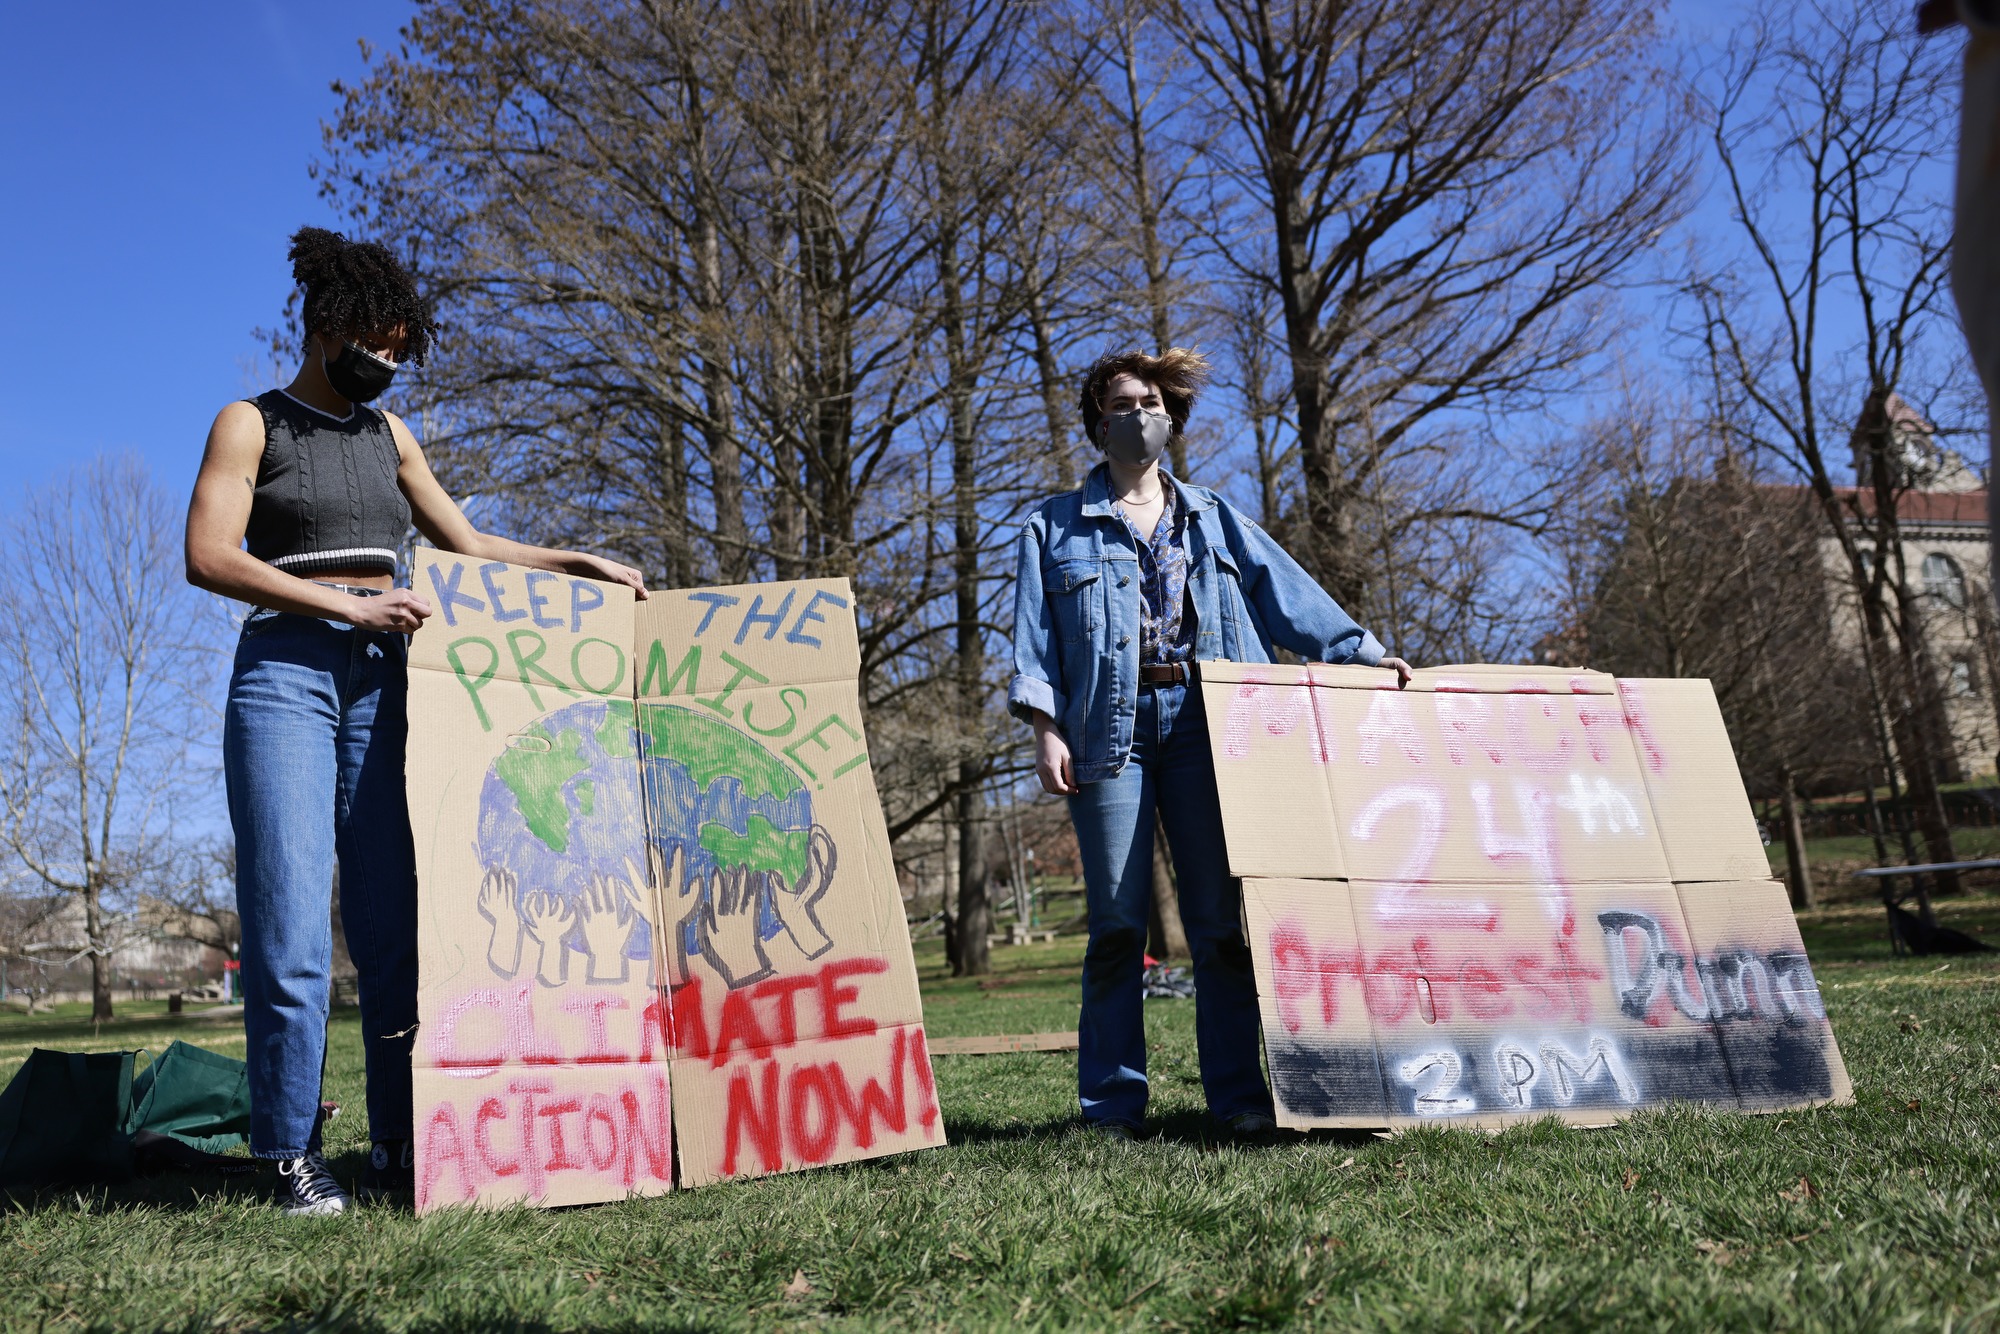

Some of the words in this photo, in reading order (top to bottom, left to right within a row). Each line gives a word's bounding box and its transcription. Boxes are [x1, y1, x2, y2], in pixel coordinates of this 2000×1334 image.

[428, 561, 604, 633] KEEP
[688, 588, 848, 650] THE
[446, 629, 868, 790] PROMISE!
[1223, 676, 1665, 774] MARCH
[434, 957, 889, 1078] CLIMATE
[1270, 917, 1602, 1034] Protest
[416, 1076, 671, 1206] ACTION
[722, 1023, 938, 1176] NOW!
[1400, 1050, 1475, 1116] 2
[1495, 1036, 1638, 1108] PM
